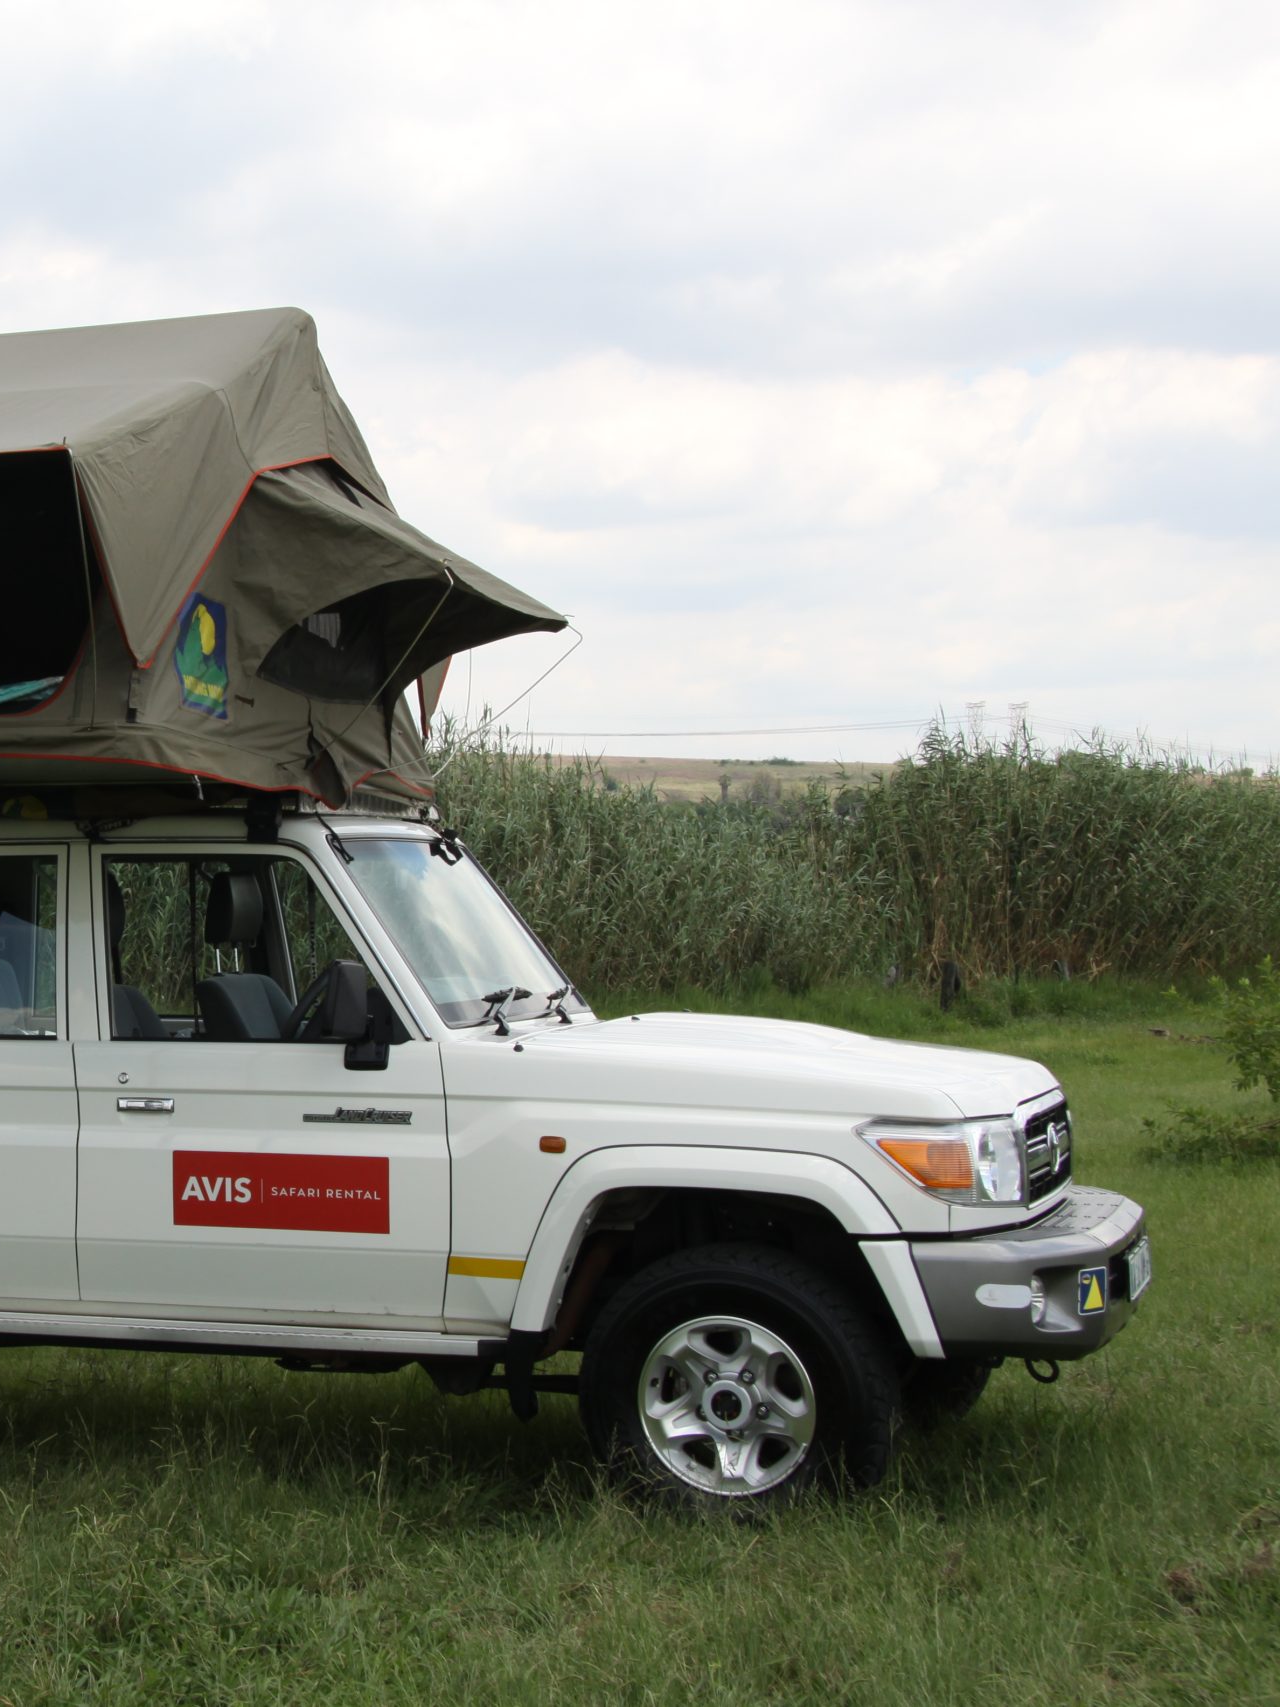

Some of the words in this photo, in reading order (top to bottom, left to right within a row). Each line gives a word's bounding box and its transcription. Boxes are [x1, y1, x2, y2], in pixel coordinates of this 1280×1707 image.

[181, 1175, 252, 1204] AVIS
[271, 1186, 320, 1198] SAFARI
[326, 1188, 381, 1201] RENTAL
